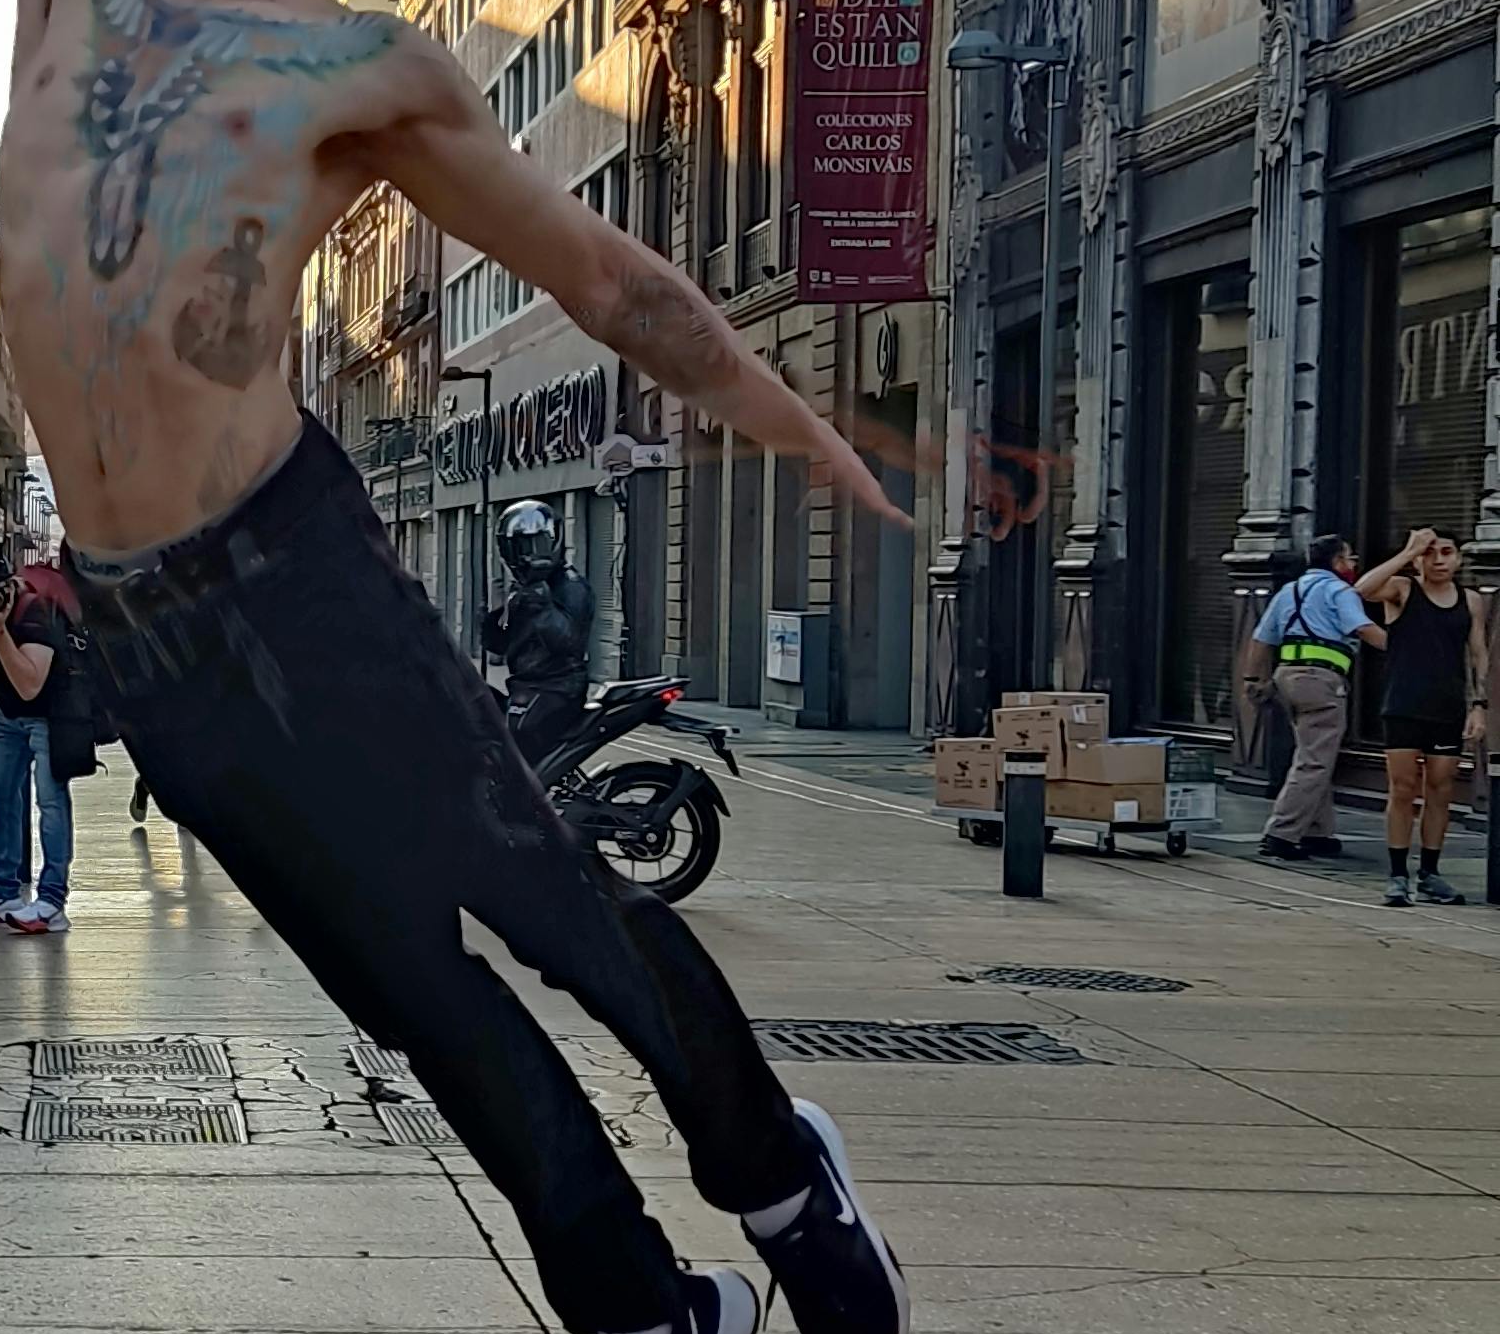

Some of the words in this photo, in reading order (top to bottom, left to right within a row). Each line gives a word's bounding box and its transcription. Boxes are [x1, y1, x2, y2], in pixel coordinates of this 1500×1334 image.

[814, 12, 920, 38] ESTAN
[816, 113, 913, 127] COLECCIONES
[825, 134, 901, 151] CARLOS
[814, 153, 913, 174] MONSIVÁIS
